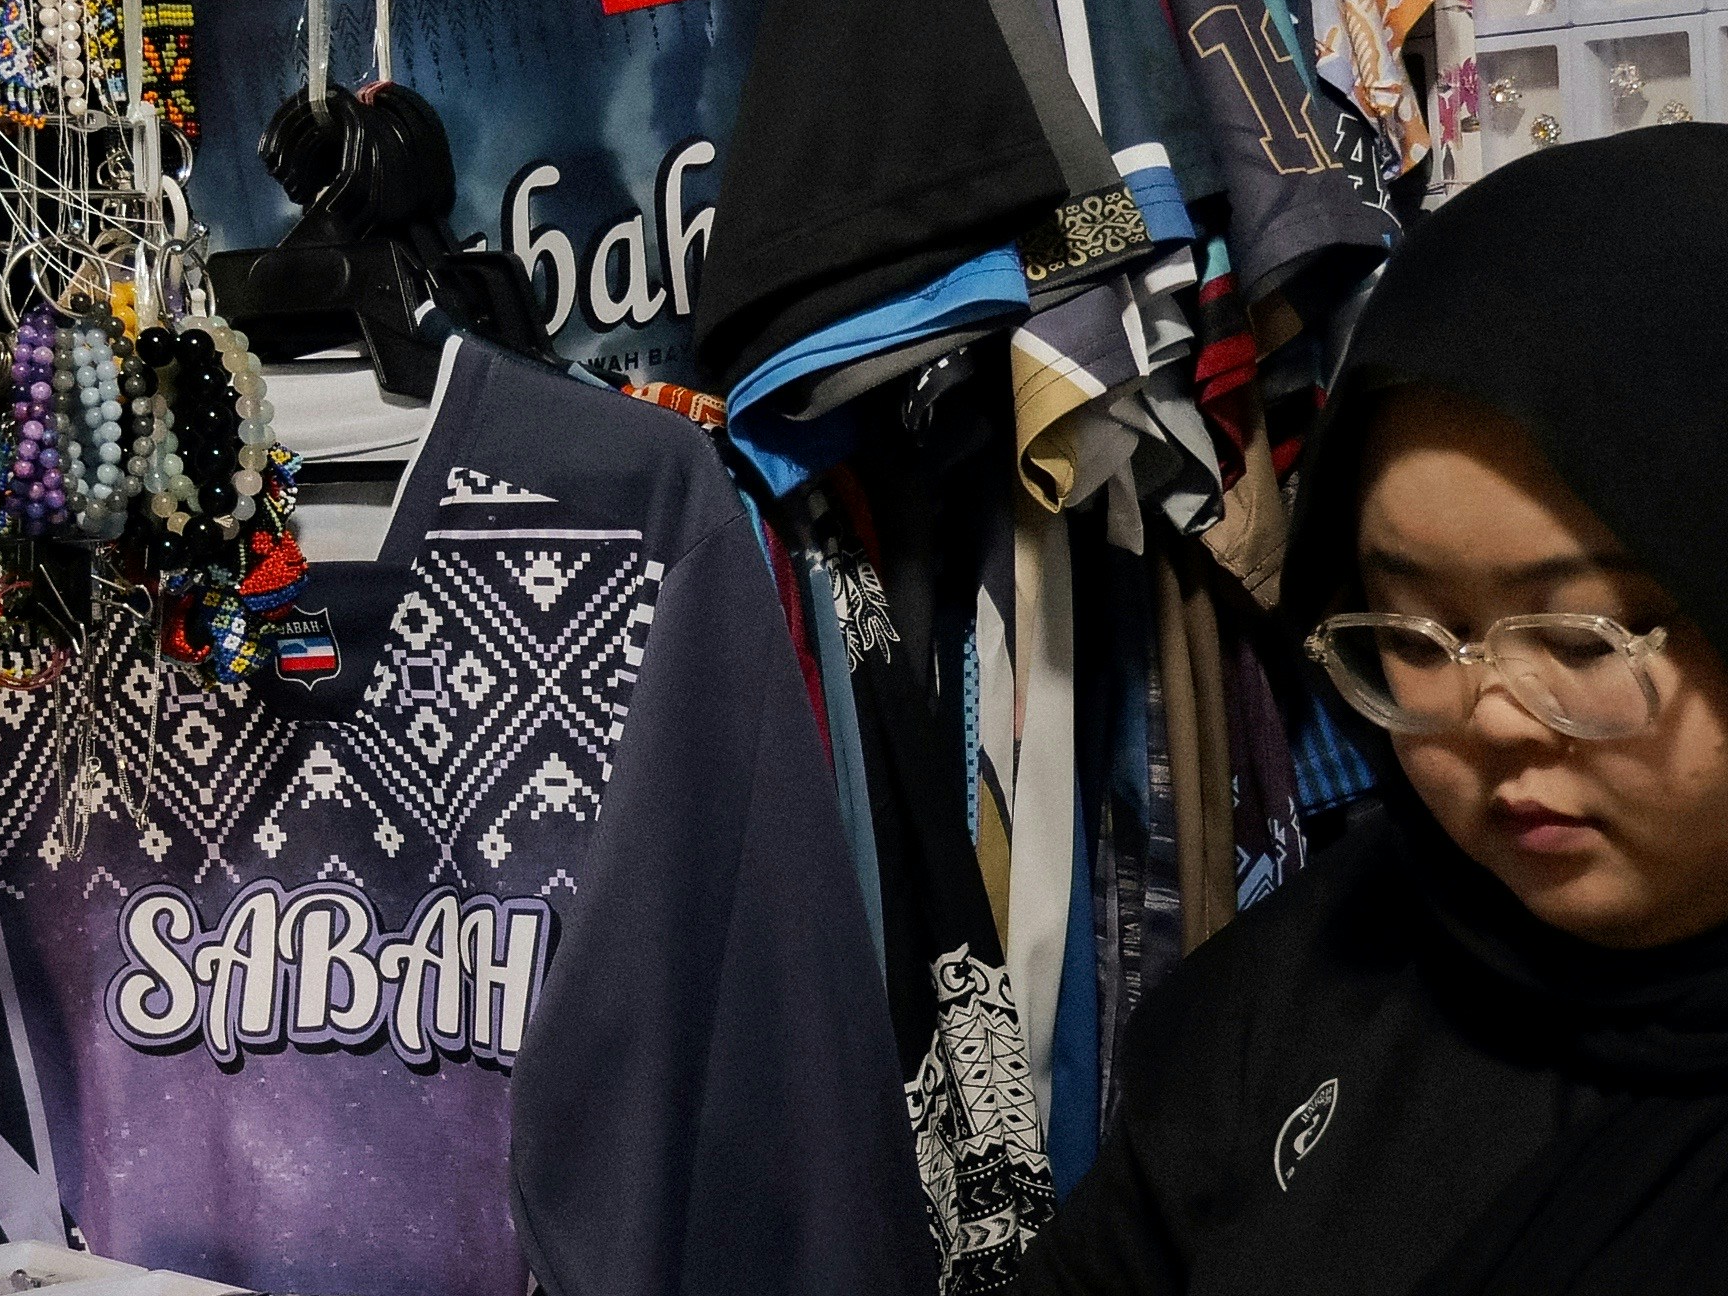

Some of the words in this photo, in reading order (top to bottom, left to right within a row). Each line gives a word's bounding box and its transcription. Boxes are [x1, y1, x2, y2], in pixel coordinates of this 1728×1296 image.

[500, 138, 716, 337] bah
[587, 351, 639, 371] WAH
[112, 882, 552, 1062] SABAH
